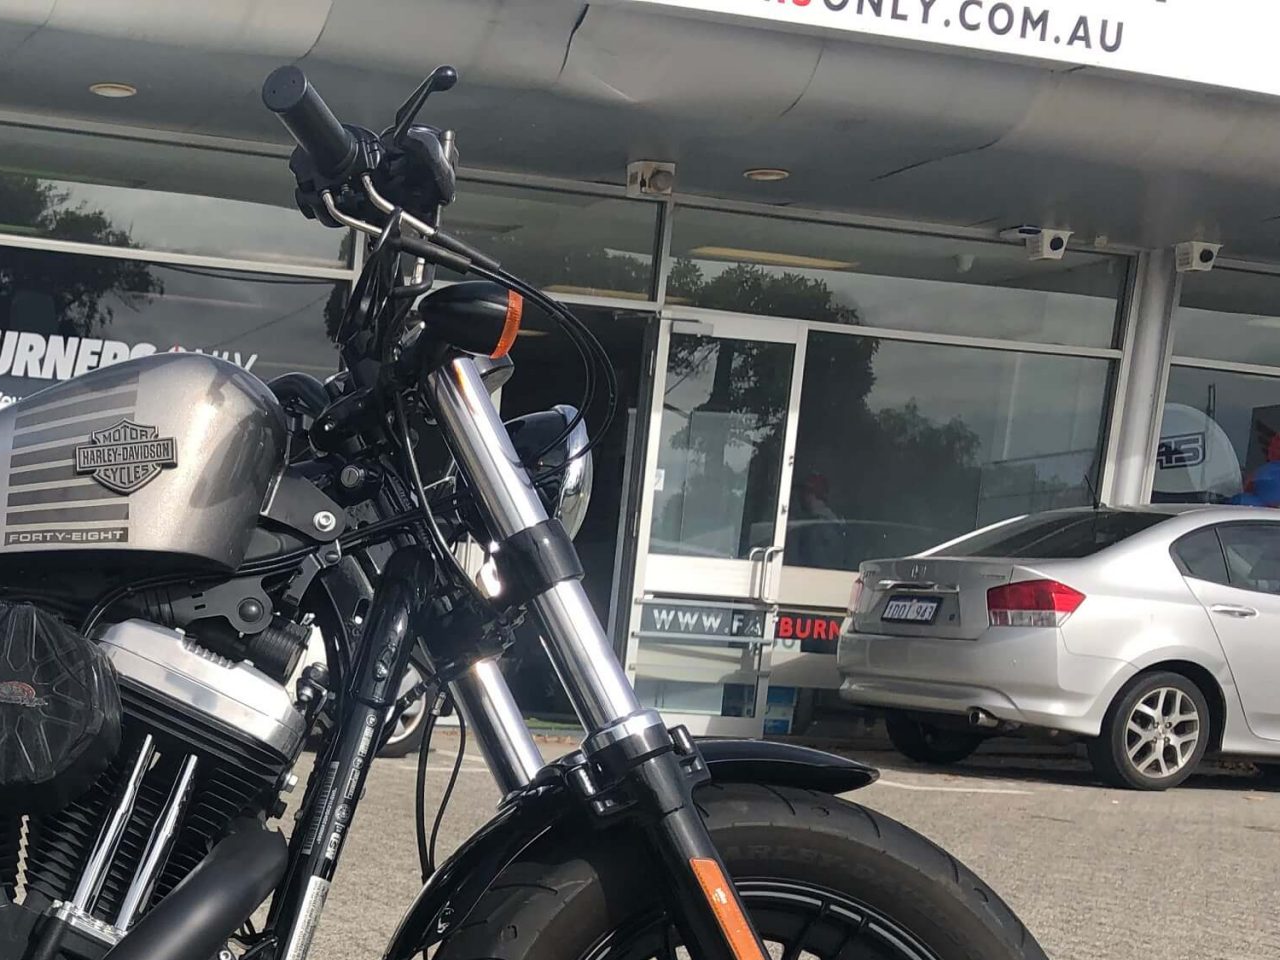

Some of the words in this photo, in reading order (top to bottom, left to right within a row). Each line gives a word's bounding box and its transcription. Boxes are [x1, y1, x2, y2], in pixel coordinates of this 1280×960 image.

[776, 0, 1124, 52] NLY.COM.AU
[102, 425, 149, 444] MOTOR
[82, 441, 170, 465] HARLEY-DAVIDSON
[103, 465, 149, 486] CYCLES
[9, 531, 124, 542] FORTY-EIGHT
